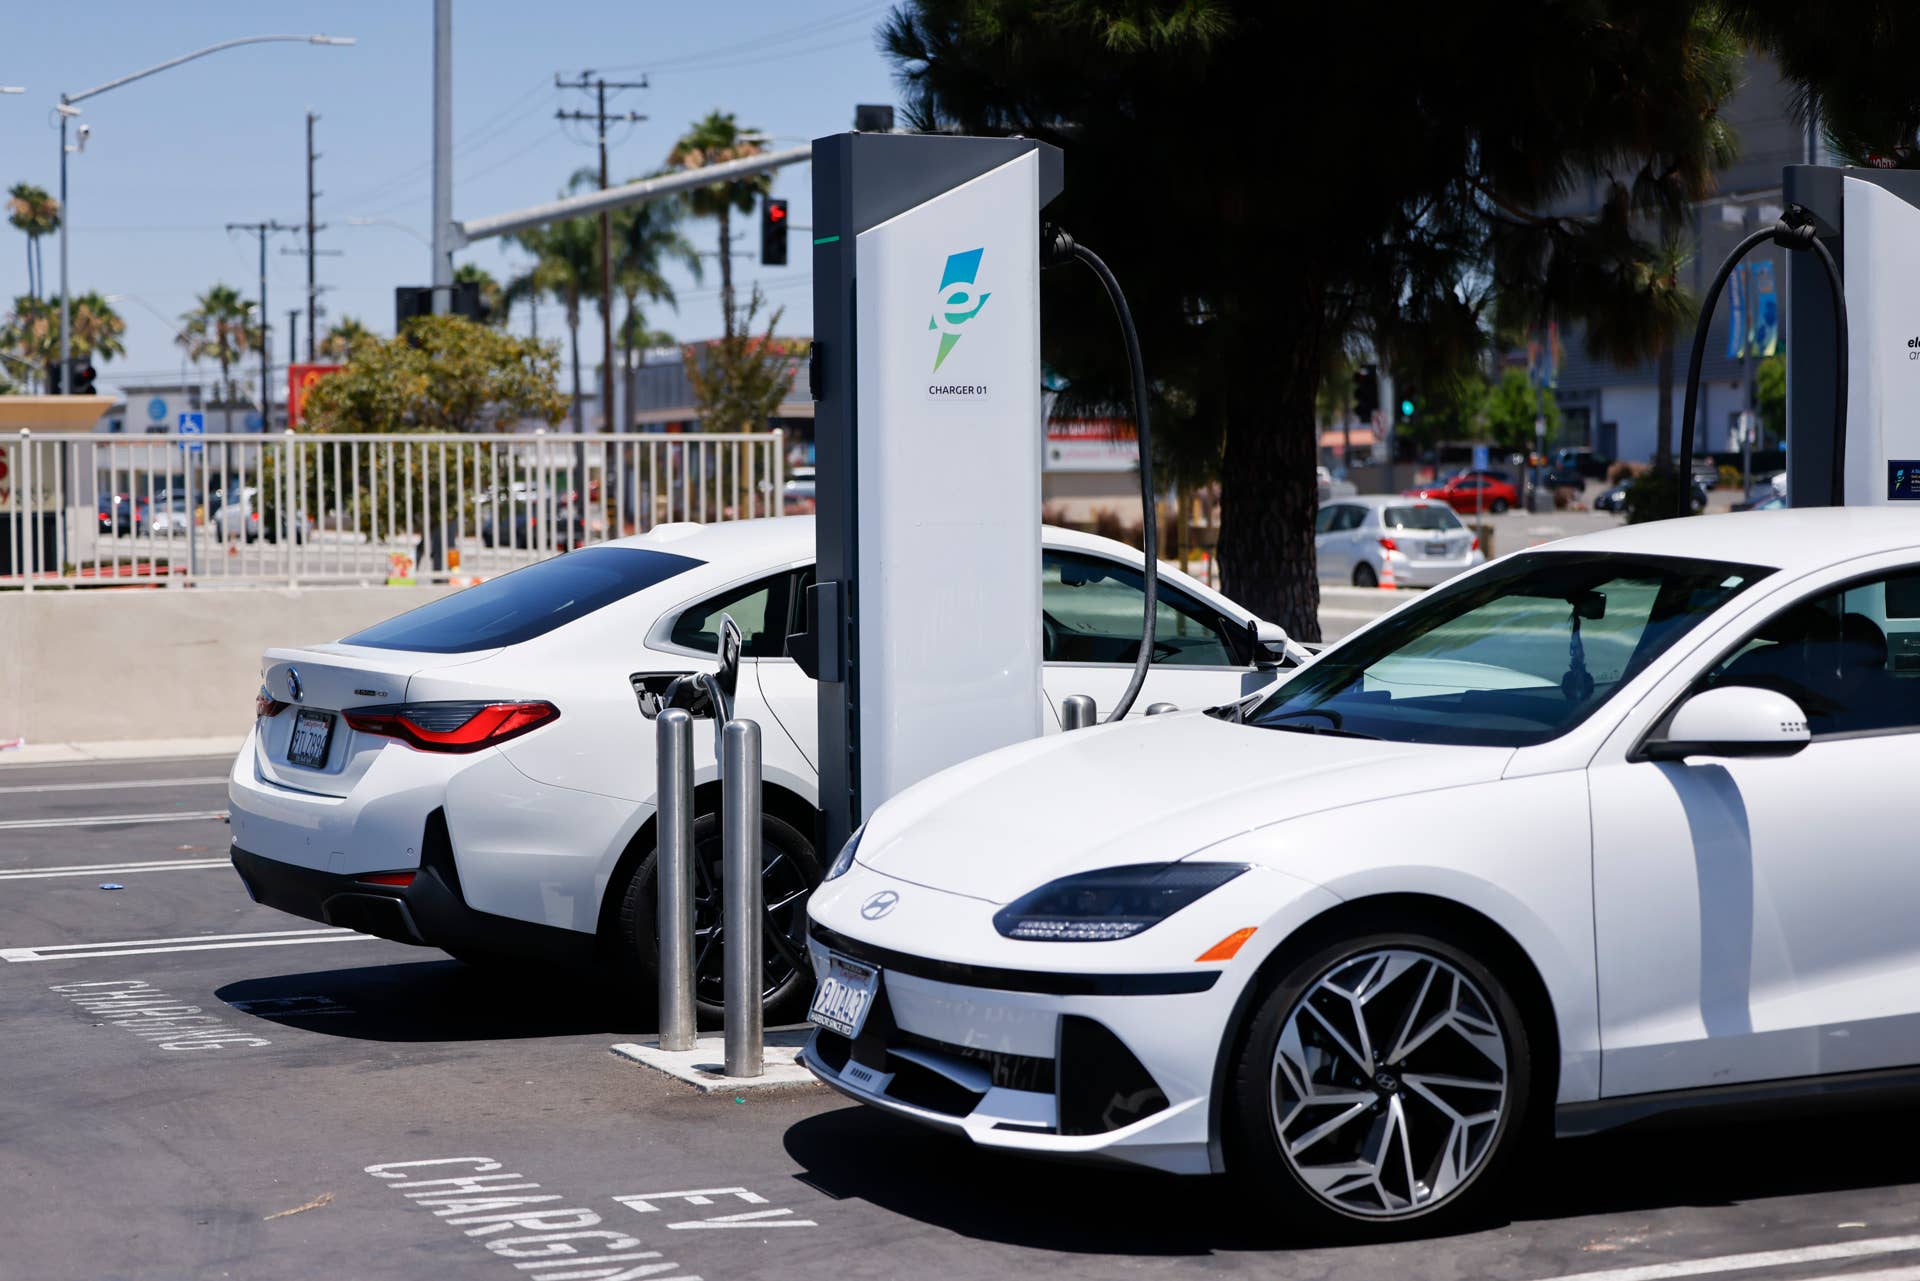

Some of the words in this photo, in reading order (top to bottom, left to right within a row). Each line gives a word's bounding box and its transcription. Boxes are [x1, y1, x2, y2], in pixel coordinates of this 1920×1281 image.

[928, 385, 975, 395] CHARGER
[976, 385, 988, 395] 01
[48, 980, 272, 1051] CHARGING
[611, 1186, 819, 1230] EV
